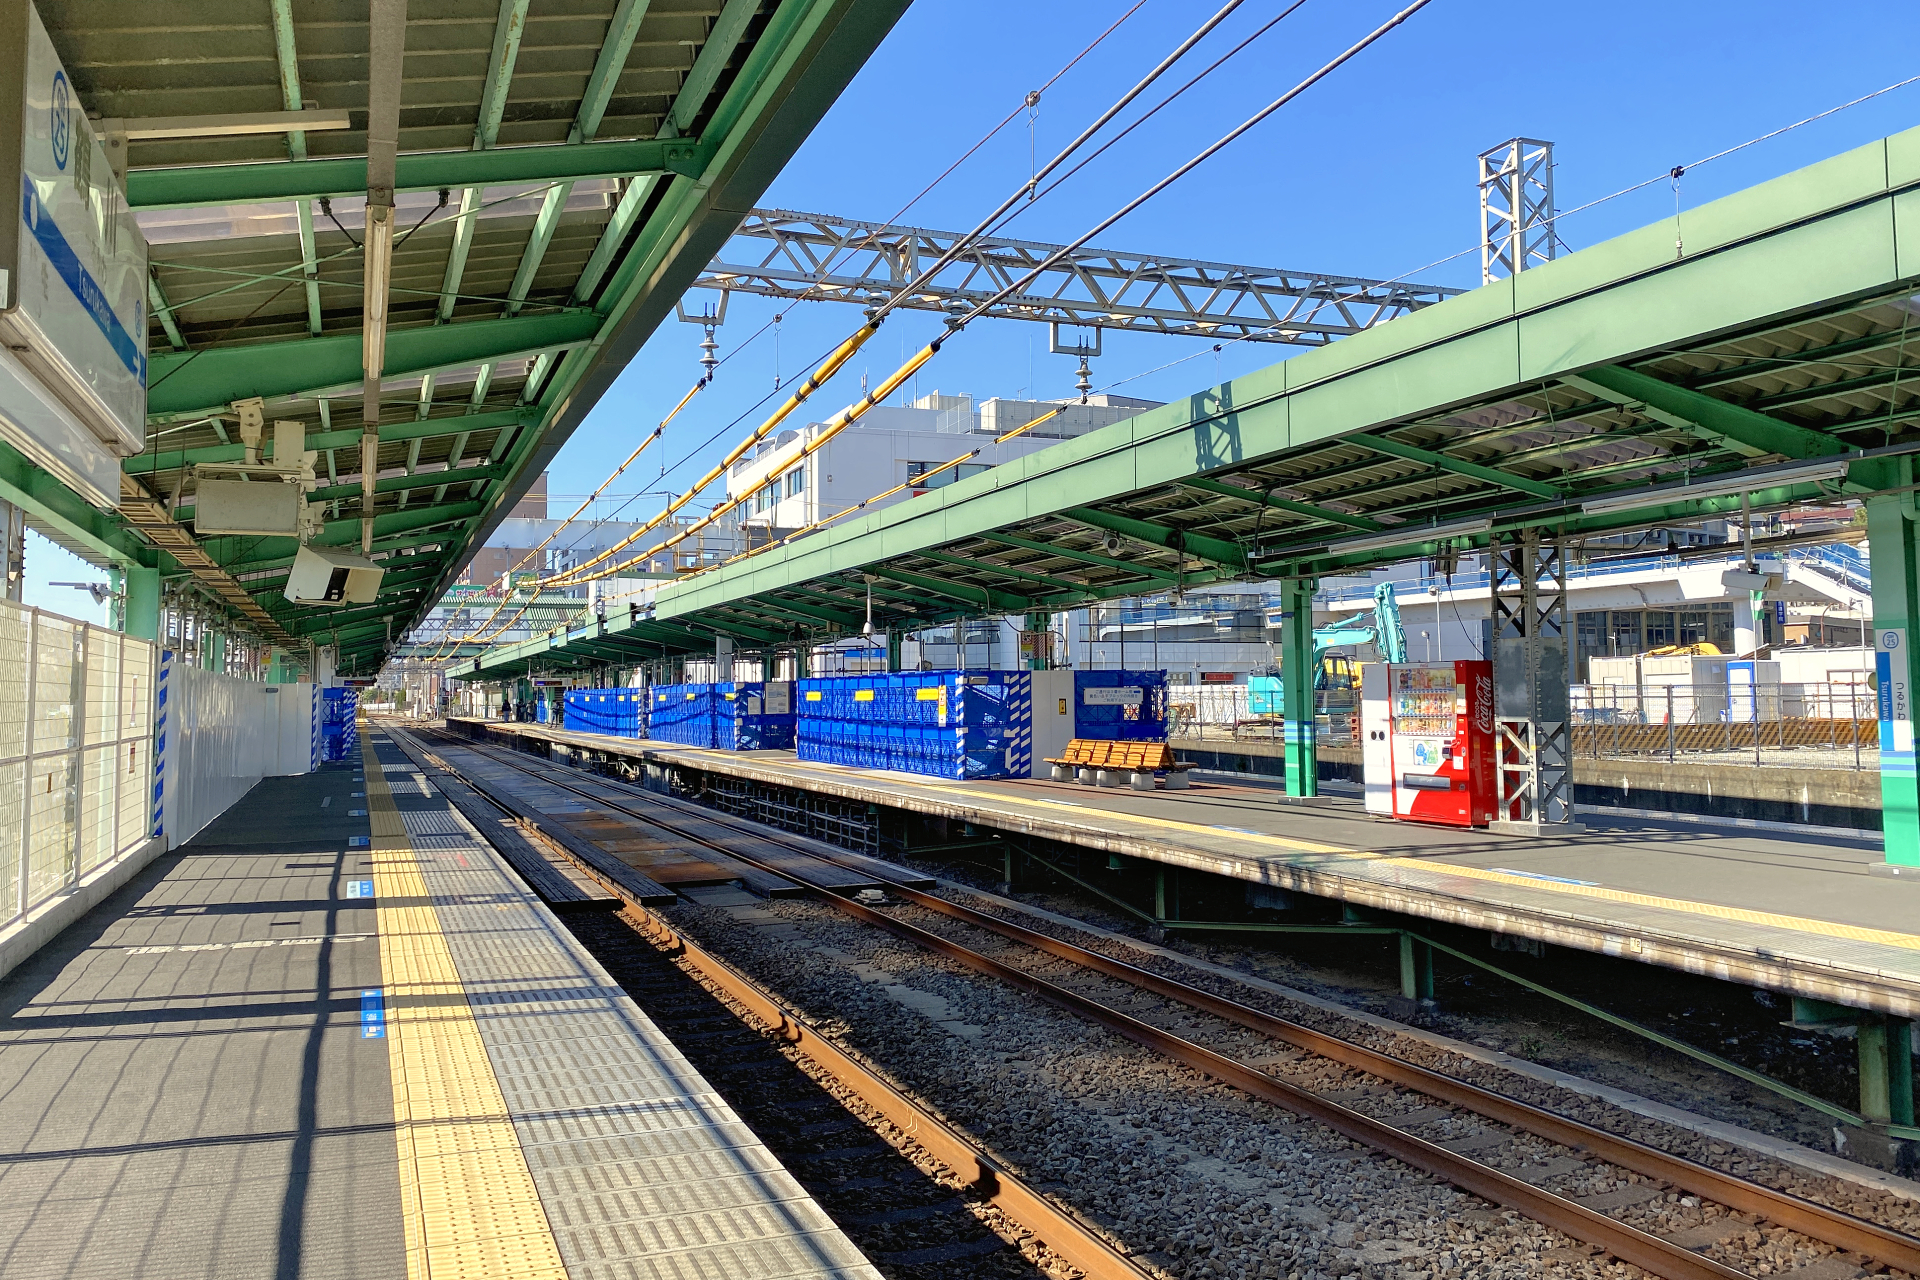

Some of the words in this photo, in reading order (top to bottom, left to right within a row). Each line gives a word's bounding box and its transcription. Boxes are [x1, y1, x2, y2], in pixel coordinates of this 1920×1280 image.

[55, 110, 65, 155] 25
[77, 261, 111, 333] Tsurukawa
[1881, 680, 1891, 722] Tsurukawa
[1895, 682, 1906, 721] つるかわ
